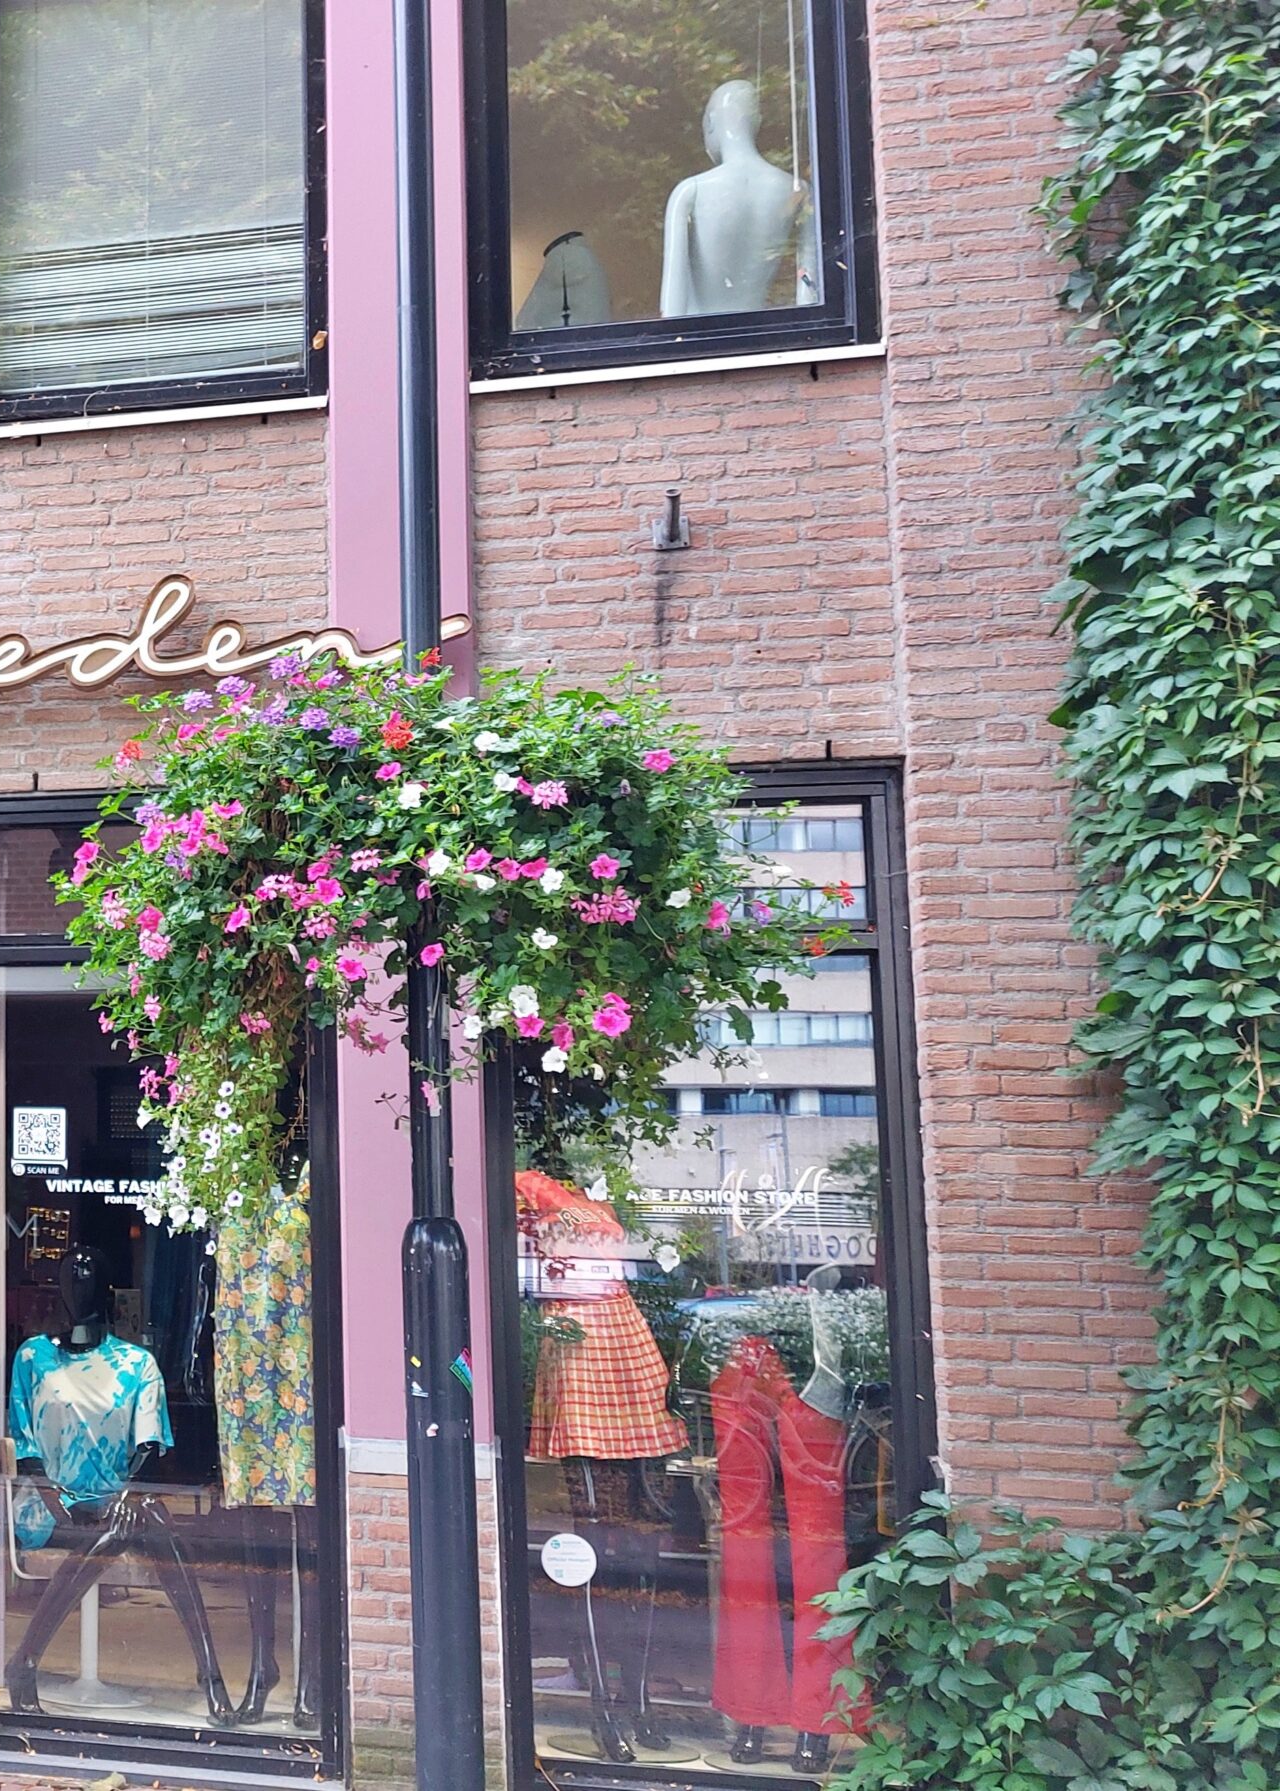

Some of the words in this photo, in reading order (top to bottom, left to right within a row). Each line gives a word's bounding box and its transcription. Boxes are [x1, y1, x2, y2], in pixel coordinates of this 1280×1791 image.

[27, 1167, 47, 1175] SCAN
[48, 1167, 60, 1175] ME
[46, 1179, 114, 1193] VINTAGE
[119, 1180, 167, 1194] FASHI
[104, 1195, 122, 1205] FOR
[668, 1188, 748, 1204] FASHION
[753, 1190, 816, 1206] STORE
